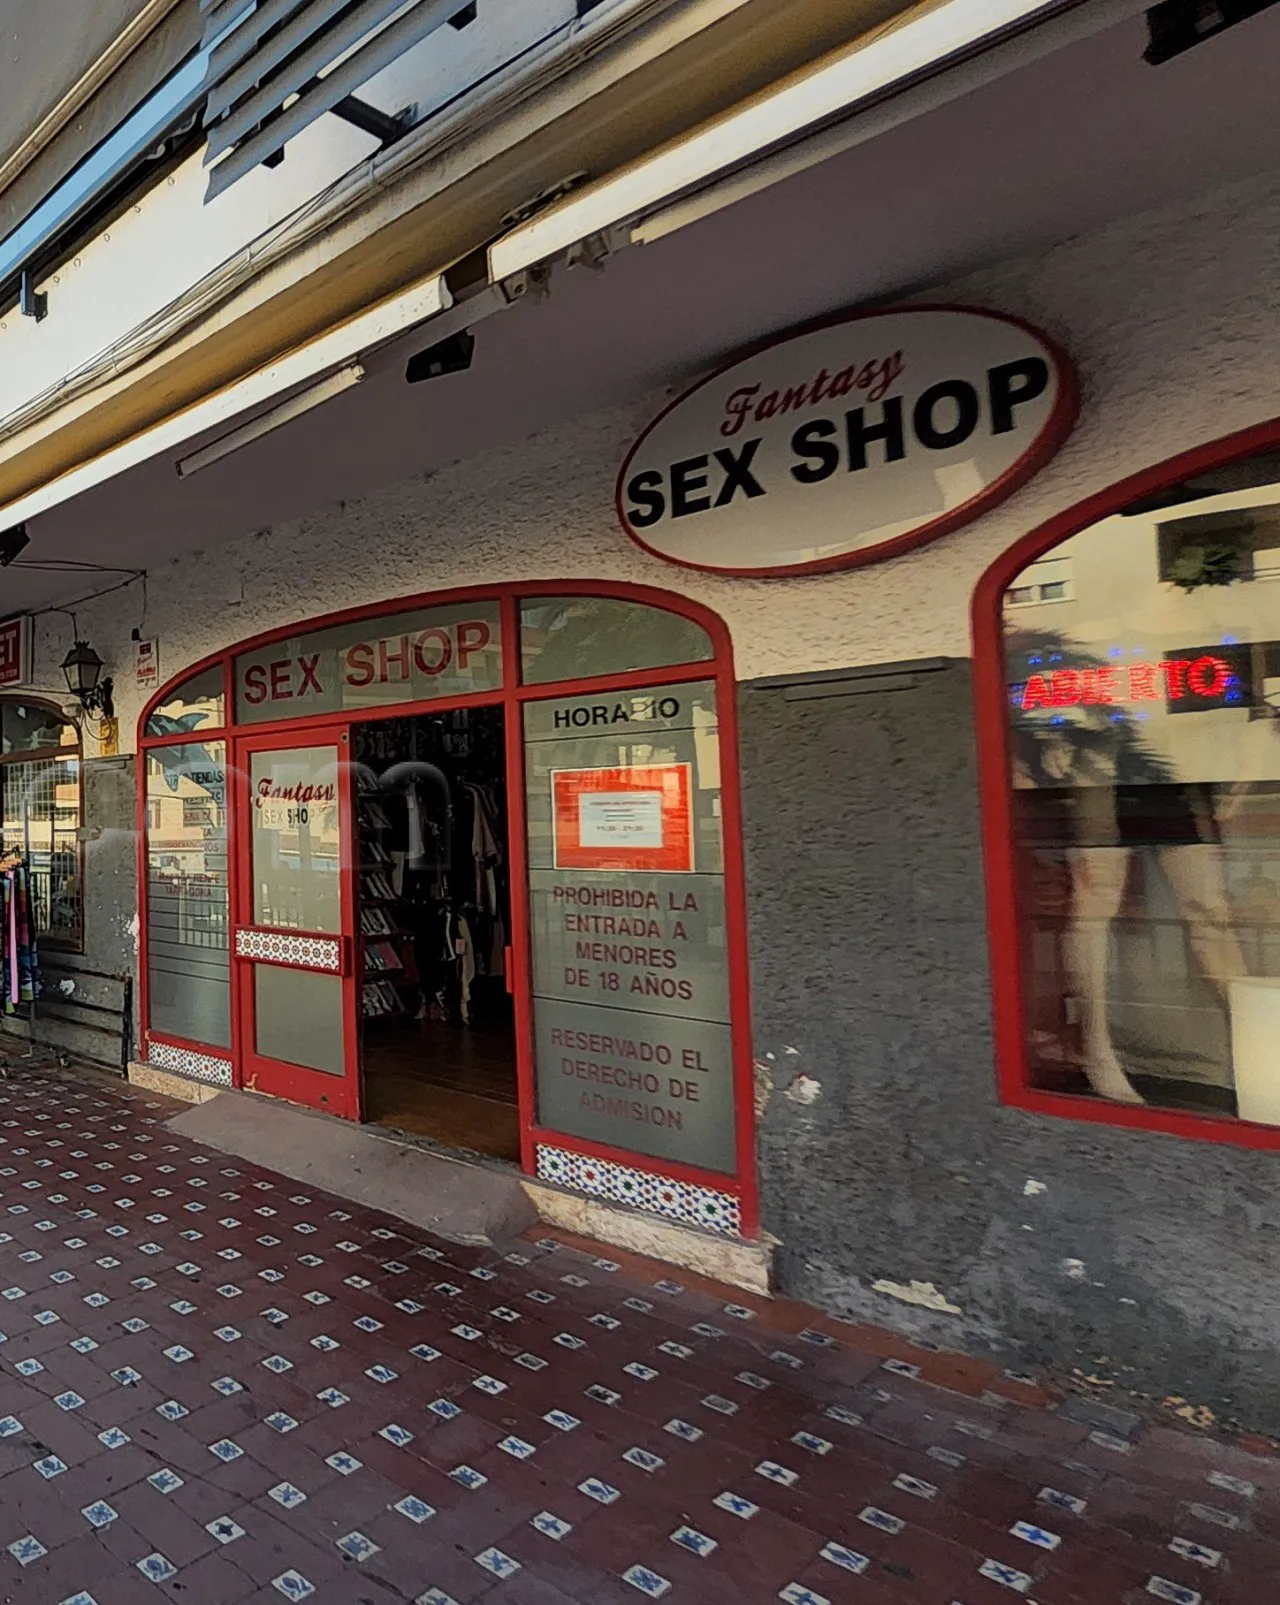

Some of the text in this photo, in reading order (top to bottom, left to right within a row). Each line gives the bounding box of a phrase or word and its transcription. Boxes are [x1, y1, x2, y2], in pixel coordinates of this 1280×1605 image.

[720, 348, 907, 437] Fantasy
[626, 356, 1049, 528] SEX SHOP
[244, 620, 491, 704] SEX SHOP
[1021, 656, 1235, 709] ABIERTO
[554, 697, 680, 728] HORAIO
[256, 778, 336, 812] Fantasy
[553, 886, 698, 912] PROHIBIDA LA
[565, 914, 687, 941] ENTRADA A
[575, 942, 677, 969] MENORES
[565, 967, 693, 1000] DE 18 AÑOS
[551, 1028, 709, 1072] RESERVADO EL
[562, 1059, 699, 1101] DERECHO DE
[579, 1090, 683, 1130] ADMISION
